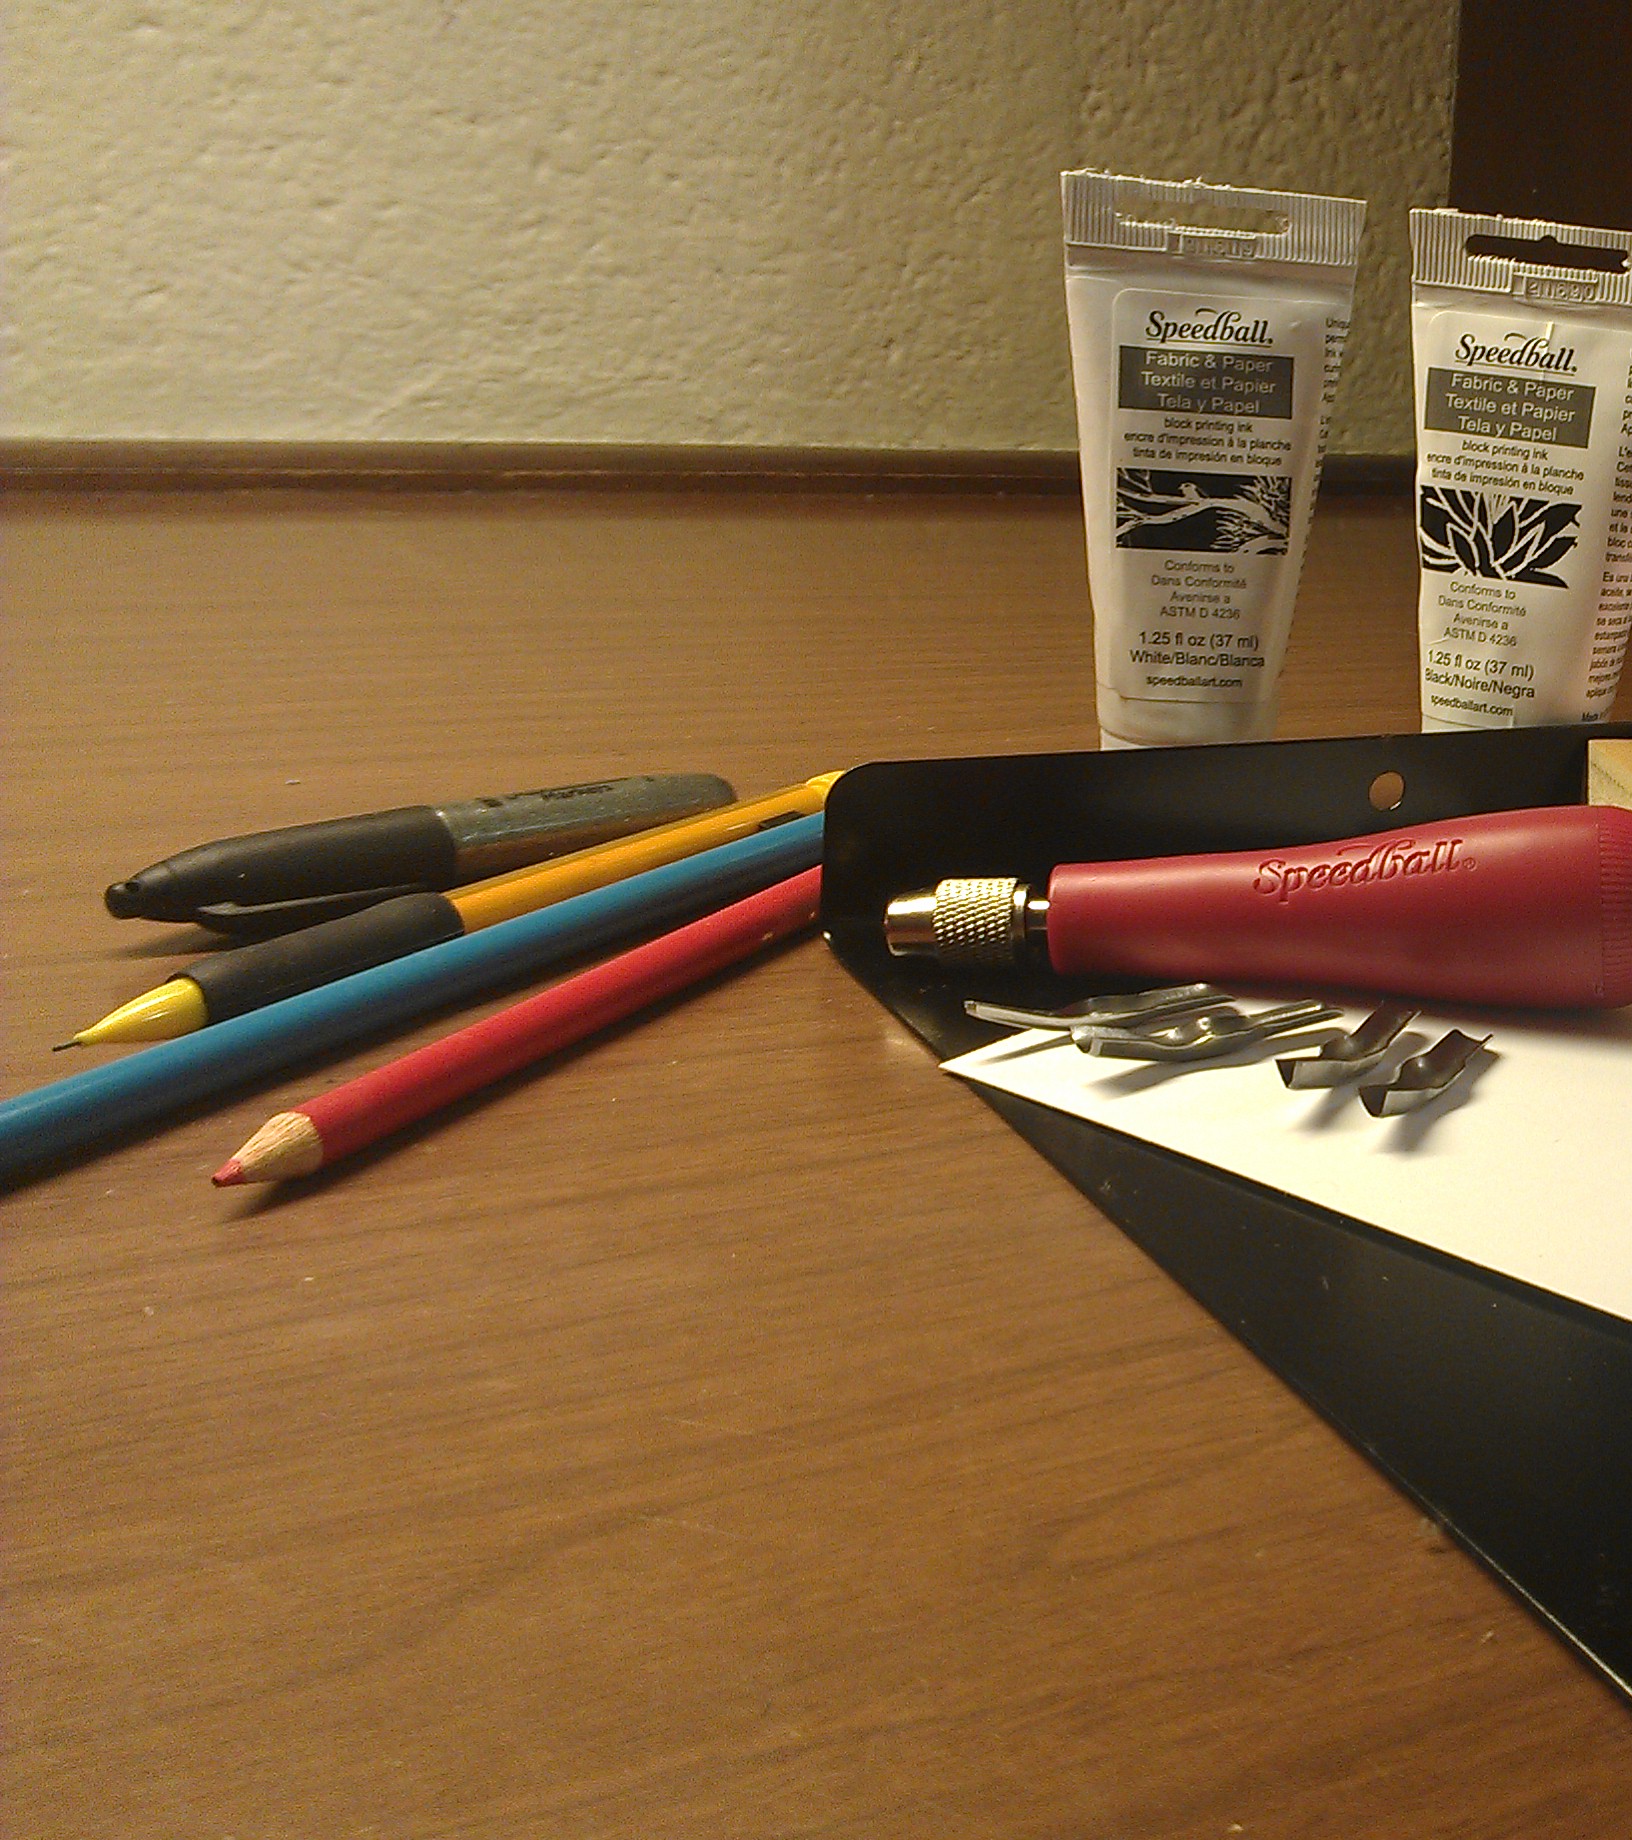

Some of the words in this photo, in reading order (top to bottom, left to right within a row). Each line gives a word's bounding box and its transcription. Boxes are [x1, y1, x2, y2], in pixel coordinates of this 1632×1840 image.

[1145, 351, 1200, 368] Fabric
[1203, 354, 1217, 369] &
[1222, 356, 1273, 374] Paper
[1141, 371, 1196, 388] Textile
[1201, 377, 1217, 390] et
[1221, 376, 1276, 395] Papier
[1451, 373, 1503, 392] Fabric
[1506, 379, 1519, 395] &
[1524, 382, 1575, 402] Paper
[1157, 393, 1191, 409] Tela
[1196, 400, 1206, 413] y
[1211, 397, 1260, 415] Papel
[1445, 393, 1497, 413] Textile
[1501, 401, 1517, 415] et
[1521, 402, 1576, 423] Papier
[1164, 417, 1192, 429] block
[1195, 420, 1235, 434] printing
[1237, 422, 1253, 432] ink
[1458, 415, 1491, 434] Tela
[1495, 423, 1506, 438] y
[1510, 422, 1557, 442] Papel
[1124, 432, 1153, 443] encre
[1157, 433, 1224, 446] d'impression
[1237, 438, 1246, 449] la
[1250, 438, 1292, 451] planche
[1462, 440, 1490, 453] block
[1491, 443, 1530, 460] printing
[1532, 448, 1549, 461] ink
[1132, 447, 1155, 458] tinta
[1158, 448, 1172, 459] de
[1175, 450, 1227, 463] impresión
[1230, 454, 1244, 463] en
[1246, 453, 1282, 466] bloque
[1426, 452, 1452, 464] encre
[1453, 455, 1519, 473] d'impression
[1521, 461, 1528, 474] à
[1531, 463, 1540, 475] la
[1543, 465, 1584, 481] planche
[1431, 467, 1452, 480] tinta
[1454, 469, 1467, 482] de
[1469, 472, 1520, 488] impresión
[1523, 479, 1536, 490] en
[1538, 481, 1574, 496] bloque
[1164, 559, 1220, 573] Conforms
[1223, 563, 1234, 573] to
[1151, 574, 1181, 586] Dans
[1224, 595, 1231, 604] a
[1450, 581, 1502, 598] Conforms
[1505, 589, 1516, 600] to
[1160, 606, 1196, 618] ASTM
[1199, 607, 1208, 618] D
[1212, 609, 1240, 620] 4236
[1438, 594, 1464, 608] Dans
[1467, 599, 1527, 617] Conformité
[1453, 613, 1498, 628] Avenirse
[1501, 622, 1508, 630] a
[1139, 631, 1171, 645] 1.25
[1175, 631, 1183, 645] fl
[1188, 635, 1206, 647] oz
[1210, 633, 1234, 650] (37
[1237, 634, 1259, 651] ml)
[1443, 626, 1475, 640] ASTM
[1478, 631, 1486, 642] D
[1489, 634, 1517, 646] 4236
[1130, 649, 1265, 667] White/Blanc/Blanca
[1428, 649, 1451, 666] 1.25
[1454, 653, 1462, 668] fl
[1465, 659, 1480, 671] oz
[1484, 659, 1508, 676] (37
[1510, 664, 1534, 682] ml)
[1146, 676, 1243, 688] speedballart.com
[1425, 667, 1535, 699] Black/Noire/Negra
[1430, 694, 1513, 716] speedballart.com
